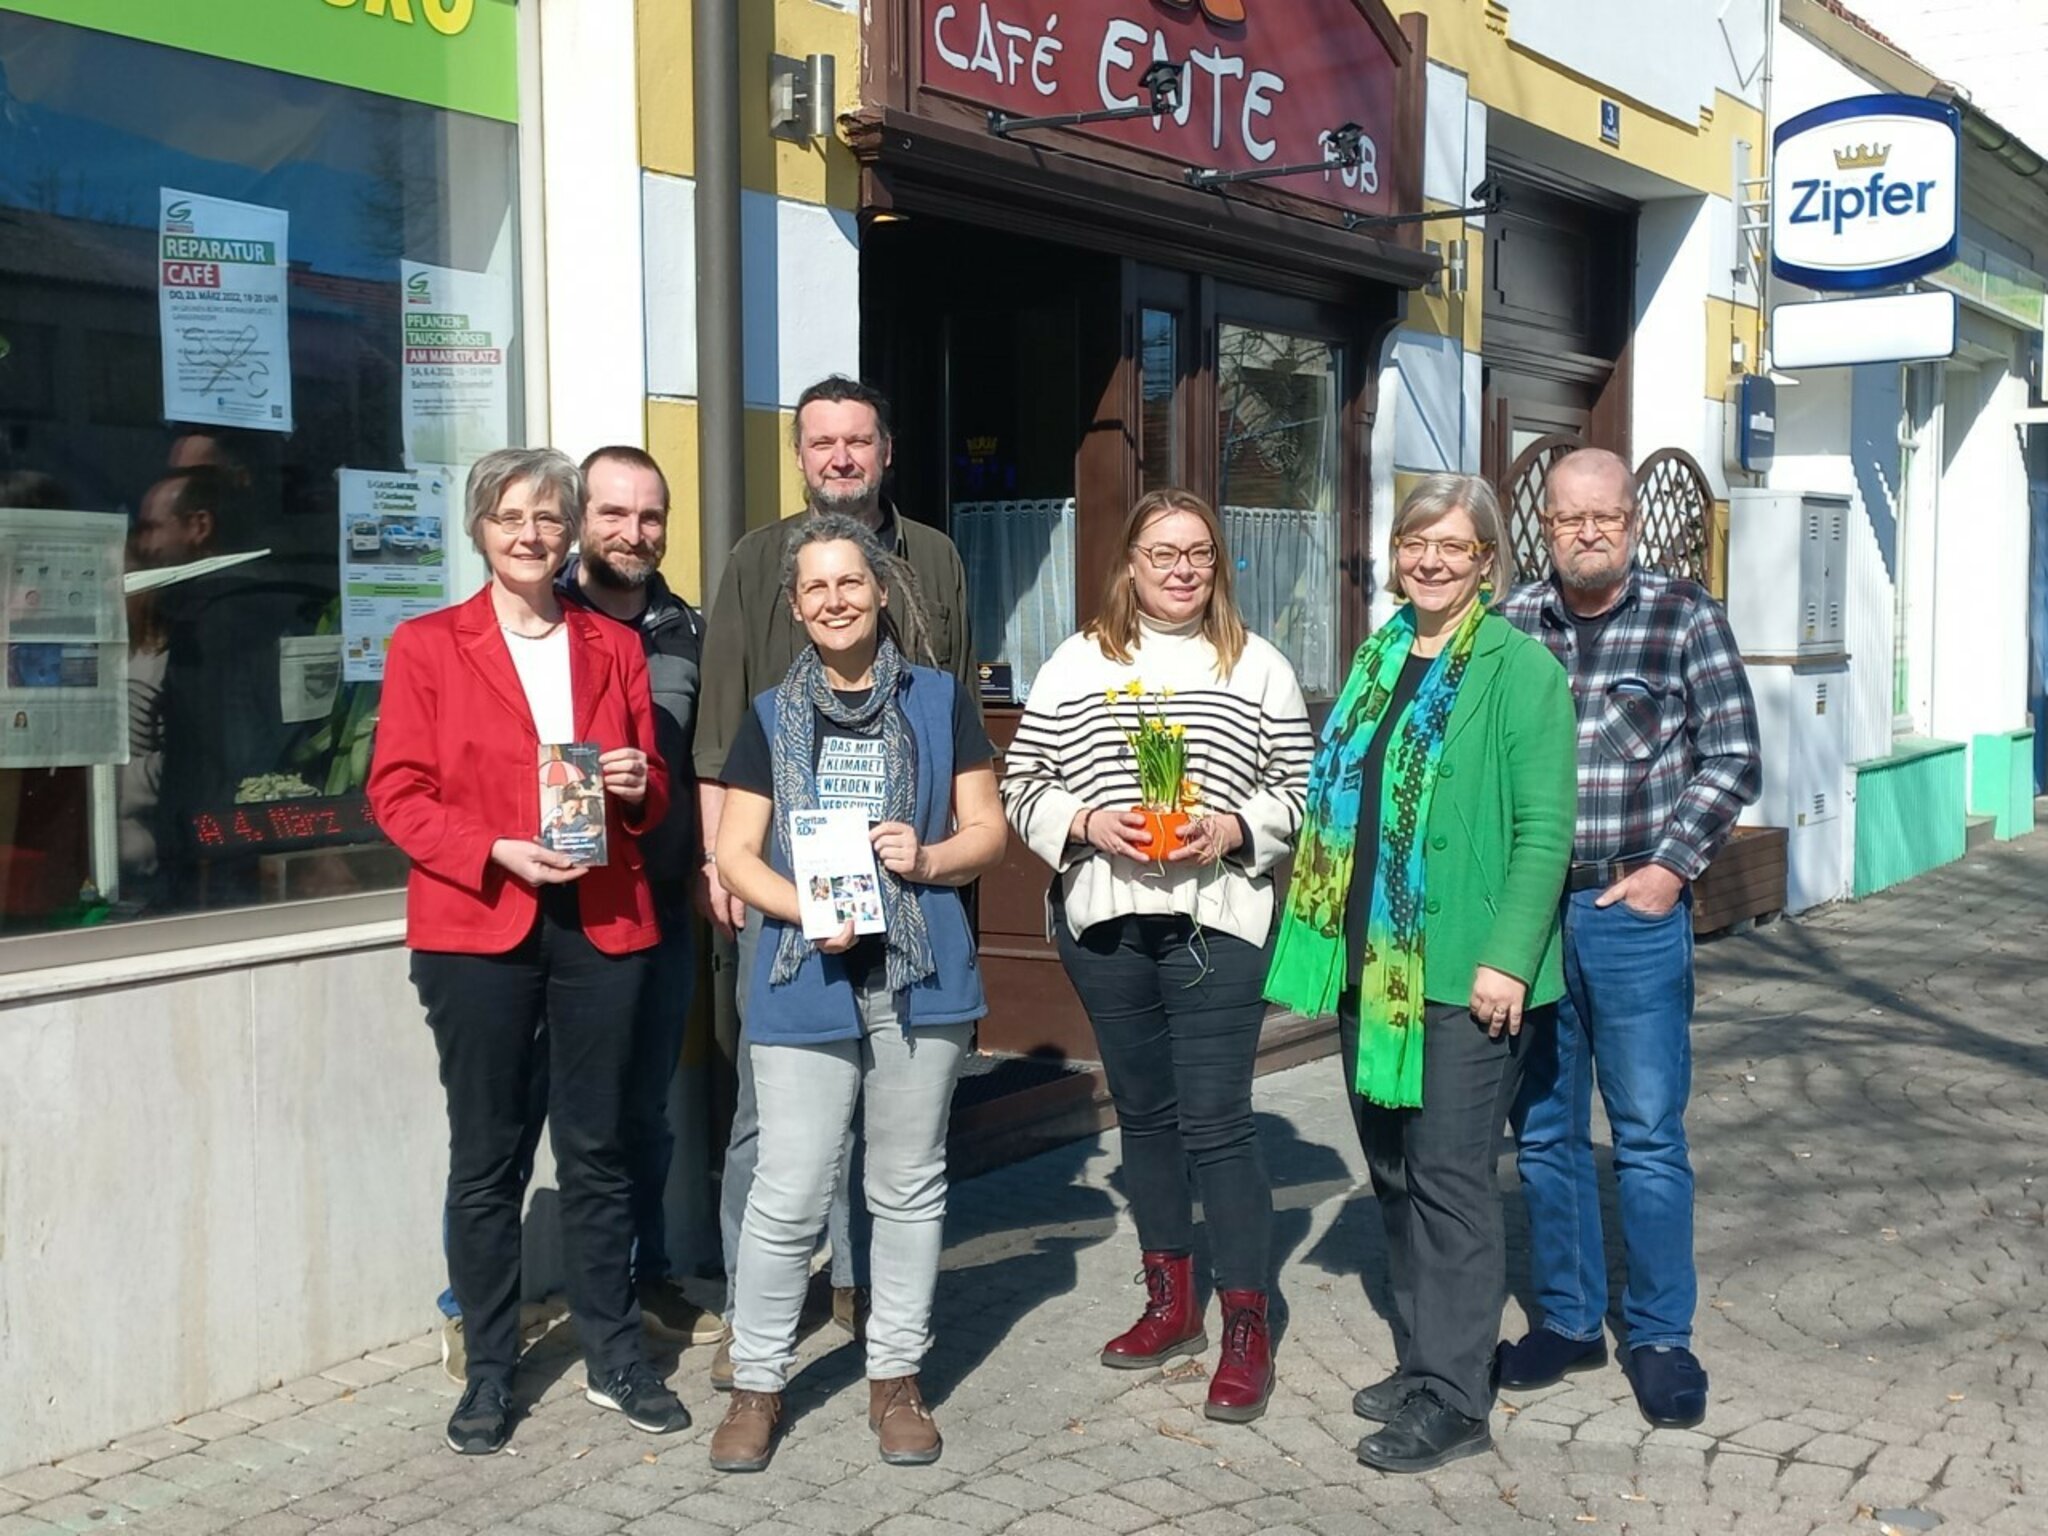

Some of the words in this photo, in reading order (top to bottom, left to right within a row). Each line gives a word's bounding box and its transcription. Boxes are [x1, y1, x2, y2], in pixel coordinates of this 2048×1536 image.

[934, 1, 1064, 96] CAFÉ
[1097, 18, 1286, 162] ENTE
[1607, 105, 1614, 126] 3
[1788, 171, 1937, 236] Zipfer
[165, 238, 266, 262] REPARATUR
[167, 263, 215, 285] CAFÉ
[406, 314, 465, 328] PFLANZEN-
[410, 350, 428, 362] AM
[430, 350, 498, 363] MARKTPLATZ
[830, 739, 852, 752] DAS
[855, 742, 874, 754] MIT
[824, 778, 871, 794] WERDEN
[794, 815, 827, 826] Caritas
